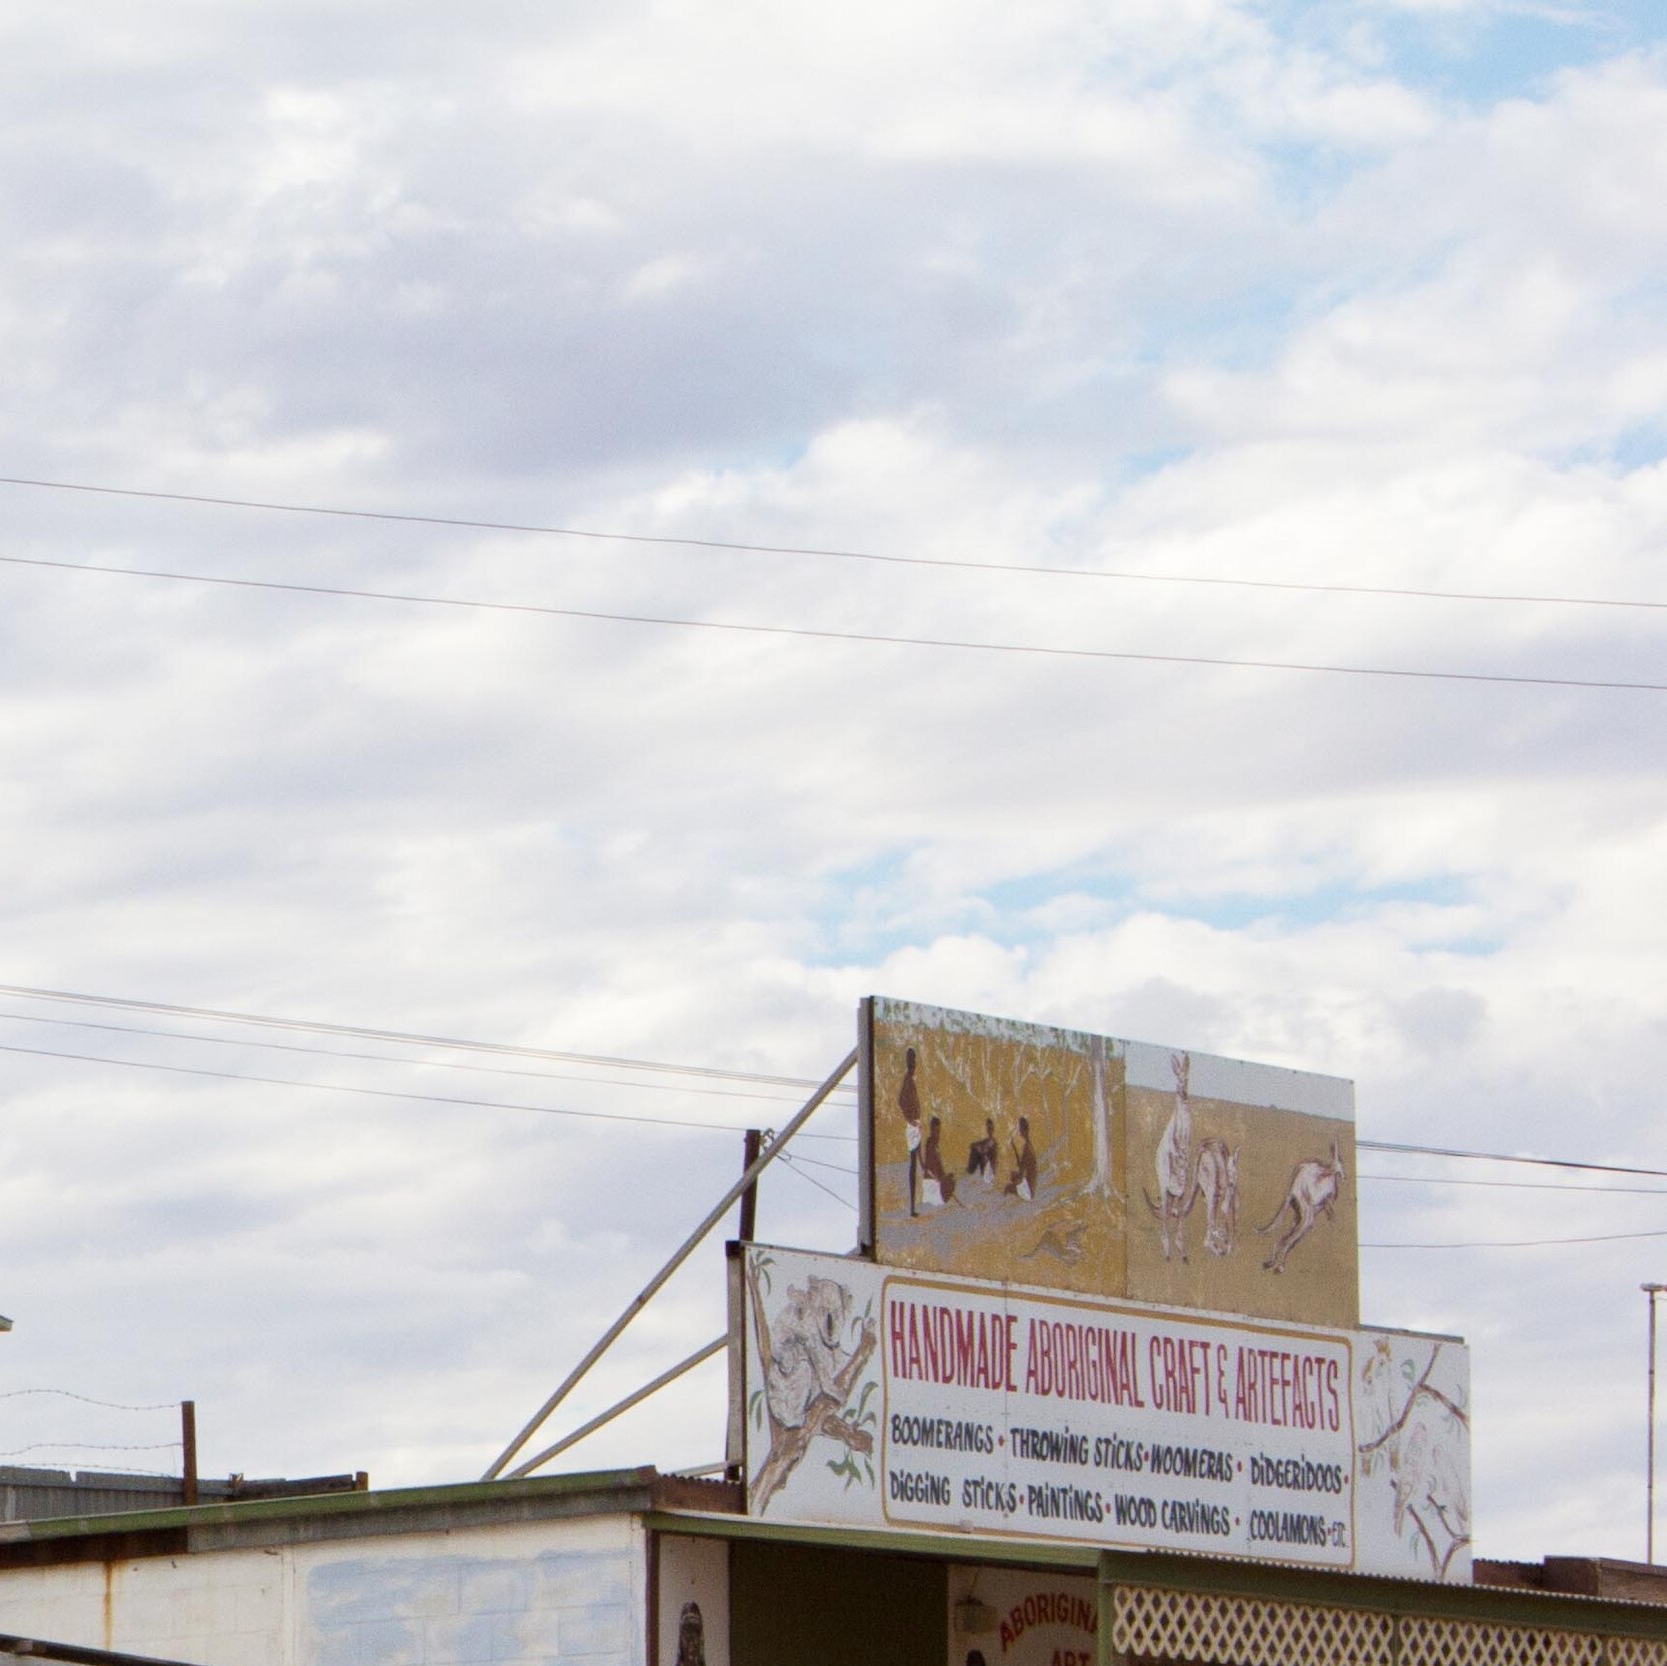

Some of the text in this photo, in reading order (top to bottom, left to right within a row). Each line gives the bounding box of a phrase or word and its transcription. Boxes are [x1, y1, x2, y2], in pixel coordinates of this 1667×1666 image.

[890, 1300, 1340, 1432] HANDMADE ABORIGINAL CRAFT & ARTEFACTS
[891, 1413, 994, 1454] BOOMERANGS
[1150, 1443, 1233, 1482] WOOMERAS
[1115, 1494, 1156, 1528] WOOD
[1249, 1509, 1326, 1547] COOLAMONS
[999, 1593, 1098, 1652] ABORIGIN
